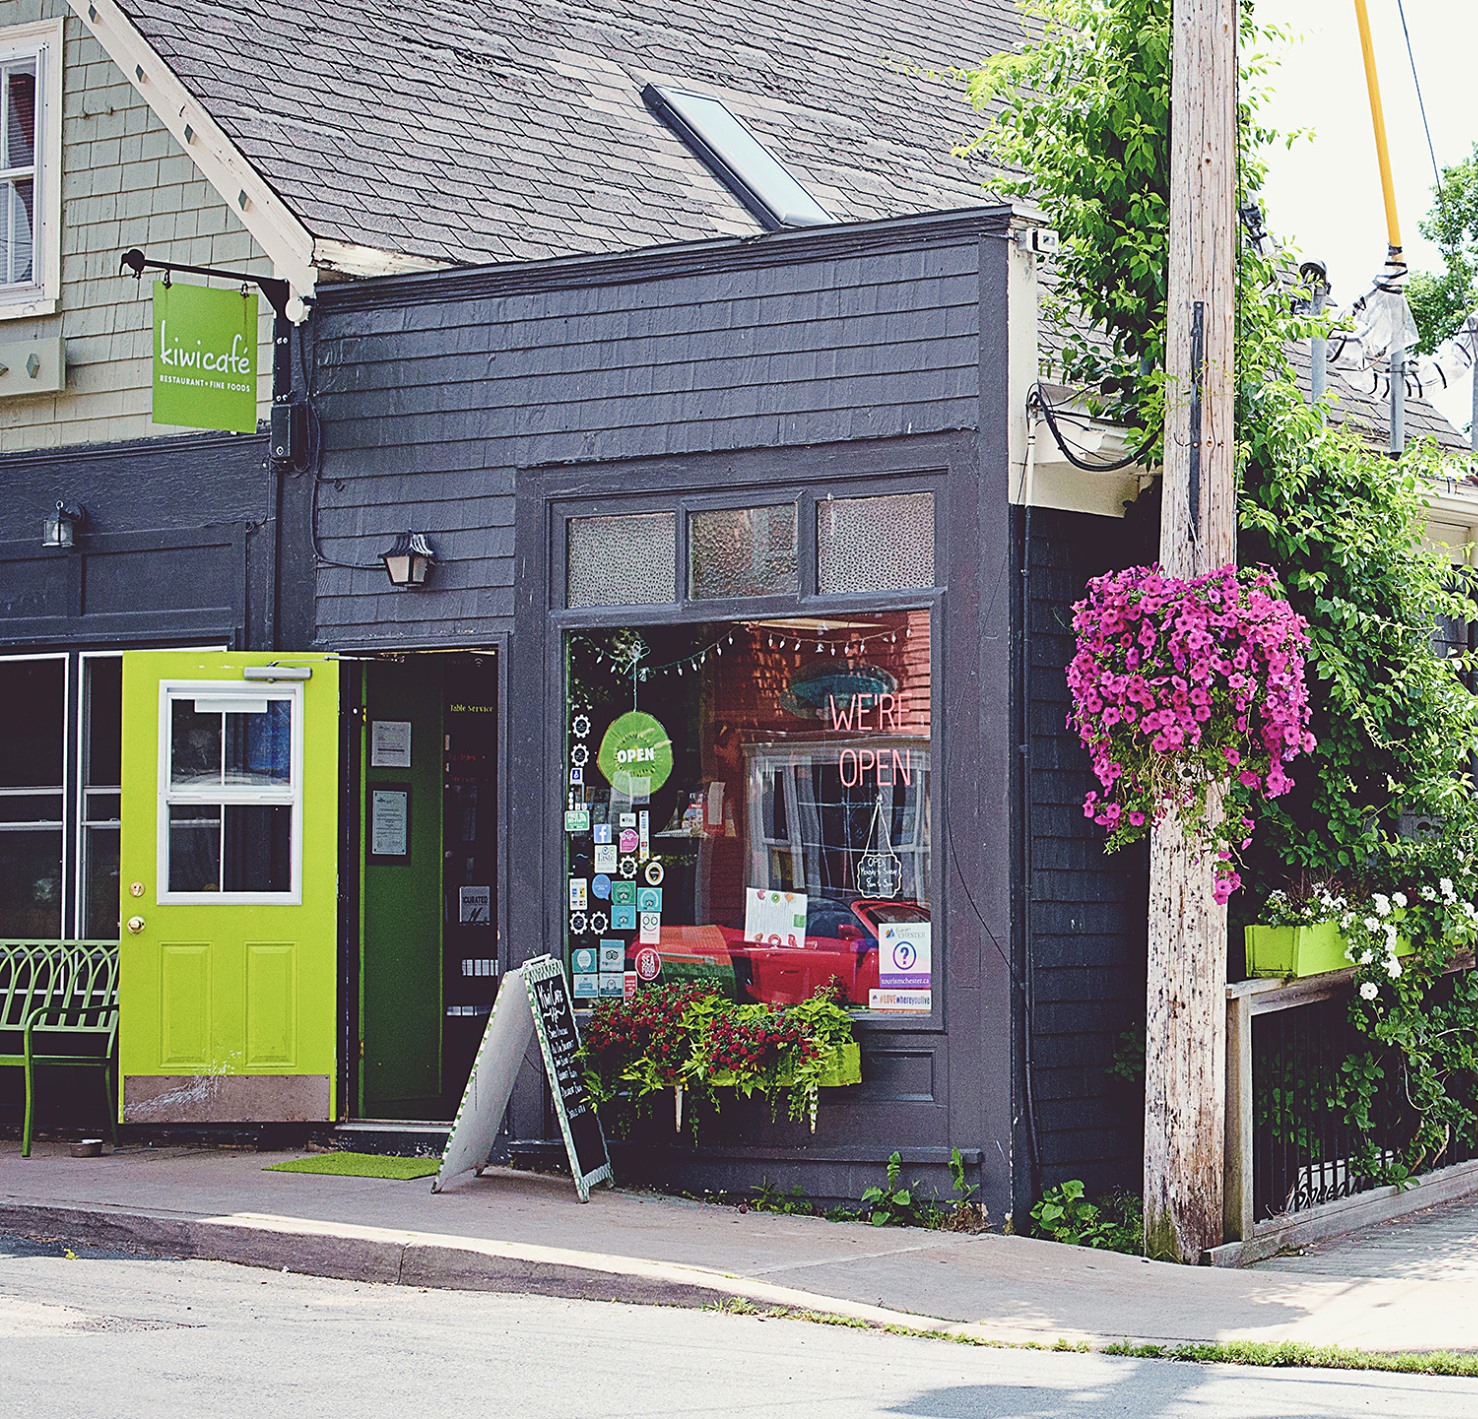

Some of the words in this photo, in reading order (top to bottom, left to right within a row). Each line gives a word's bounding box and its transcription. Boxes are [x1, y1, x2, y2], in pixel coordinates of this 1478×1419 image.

[160, 319, 250, 374] kiwicafé
[160, 374, 204, 387] RESTAURANT
[210, 381, 225, 389] FINE
[227, 382, 250, 392] FOODS
[830, 694, 913, 731] WE'RE
[617, 747, 655, 763] OPEN
[839, 749, 911, 787] OPEN
[897, 931, 926, 939] CHESTER
